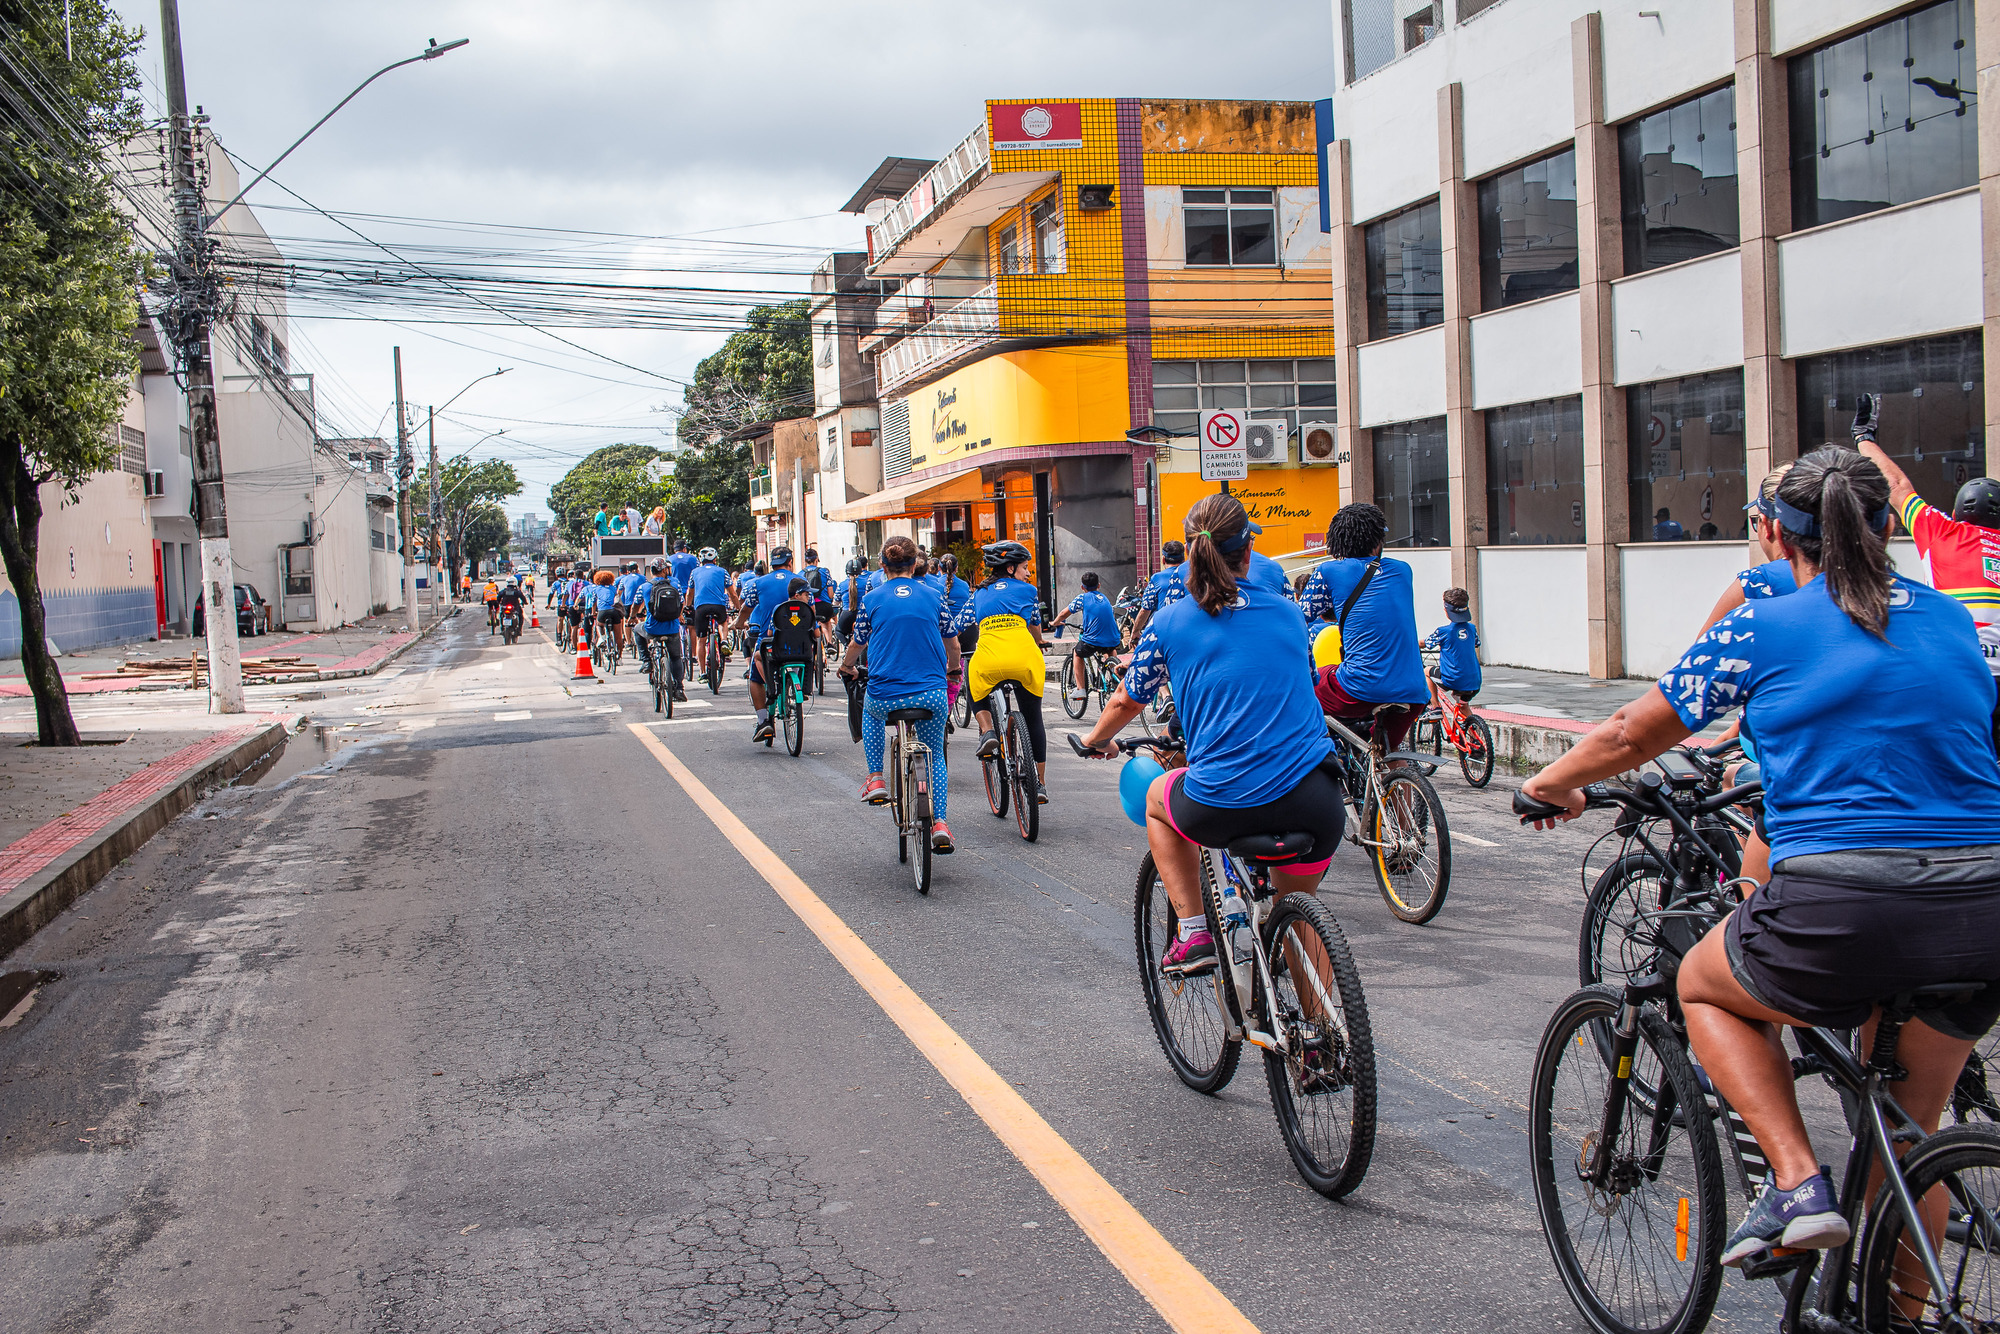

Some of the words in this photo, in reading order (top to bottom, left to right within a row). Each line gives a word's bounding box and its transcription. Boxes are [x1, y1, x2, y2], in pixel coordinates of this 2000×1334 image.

[1338, 451, 1350, 463] 443
[1205, 460, 1244, 468] CAMINHÕES
[1216, 469, 1241, 477] ÔNIBUS
[1229, 487, 1286, 499] Restaurante
[1247, 503, 1261, 518] de
[1265, 504, 1312, 518] Minas
